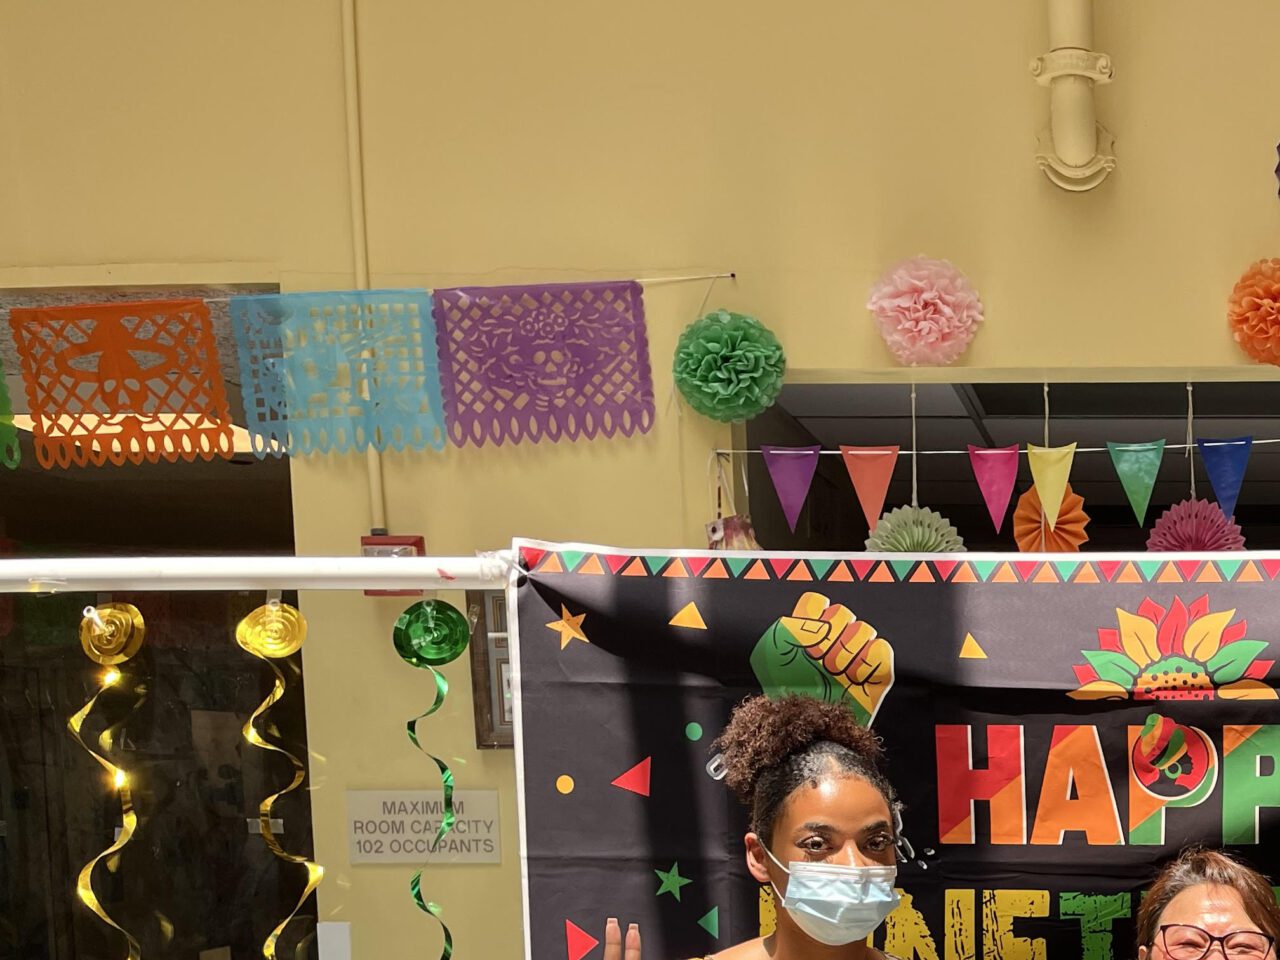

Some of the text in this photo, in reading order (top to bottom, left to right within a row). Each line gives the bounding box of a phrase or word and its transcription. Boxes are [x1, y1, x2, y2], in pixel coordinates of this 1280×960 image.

[353, 819, 494, 834] ROOM CAPCITY
[356, 839, 384, 854] 102
